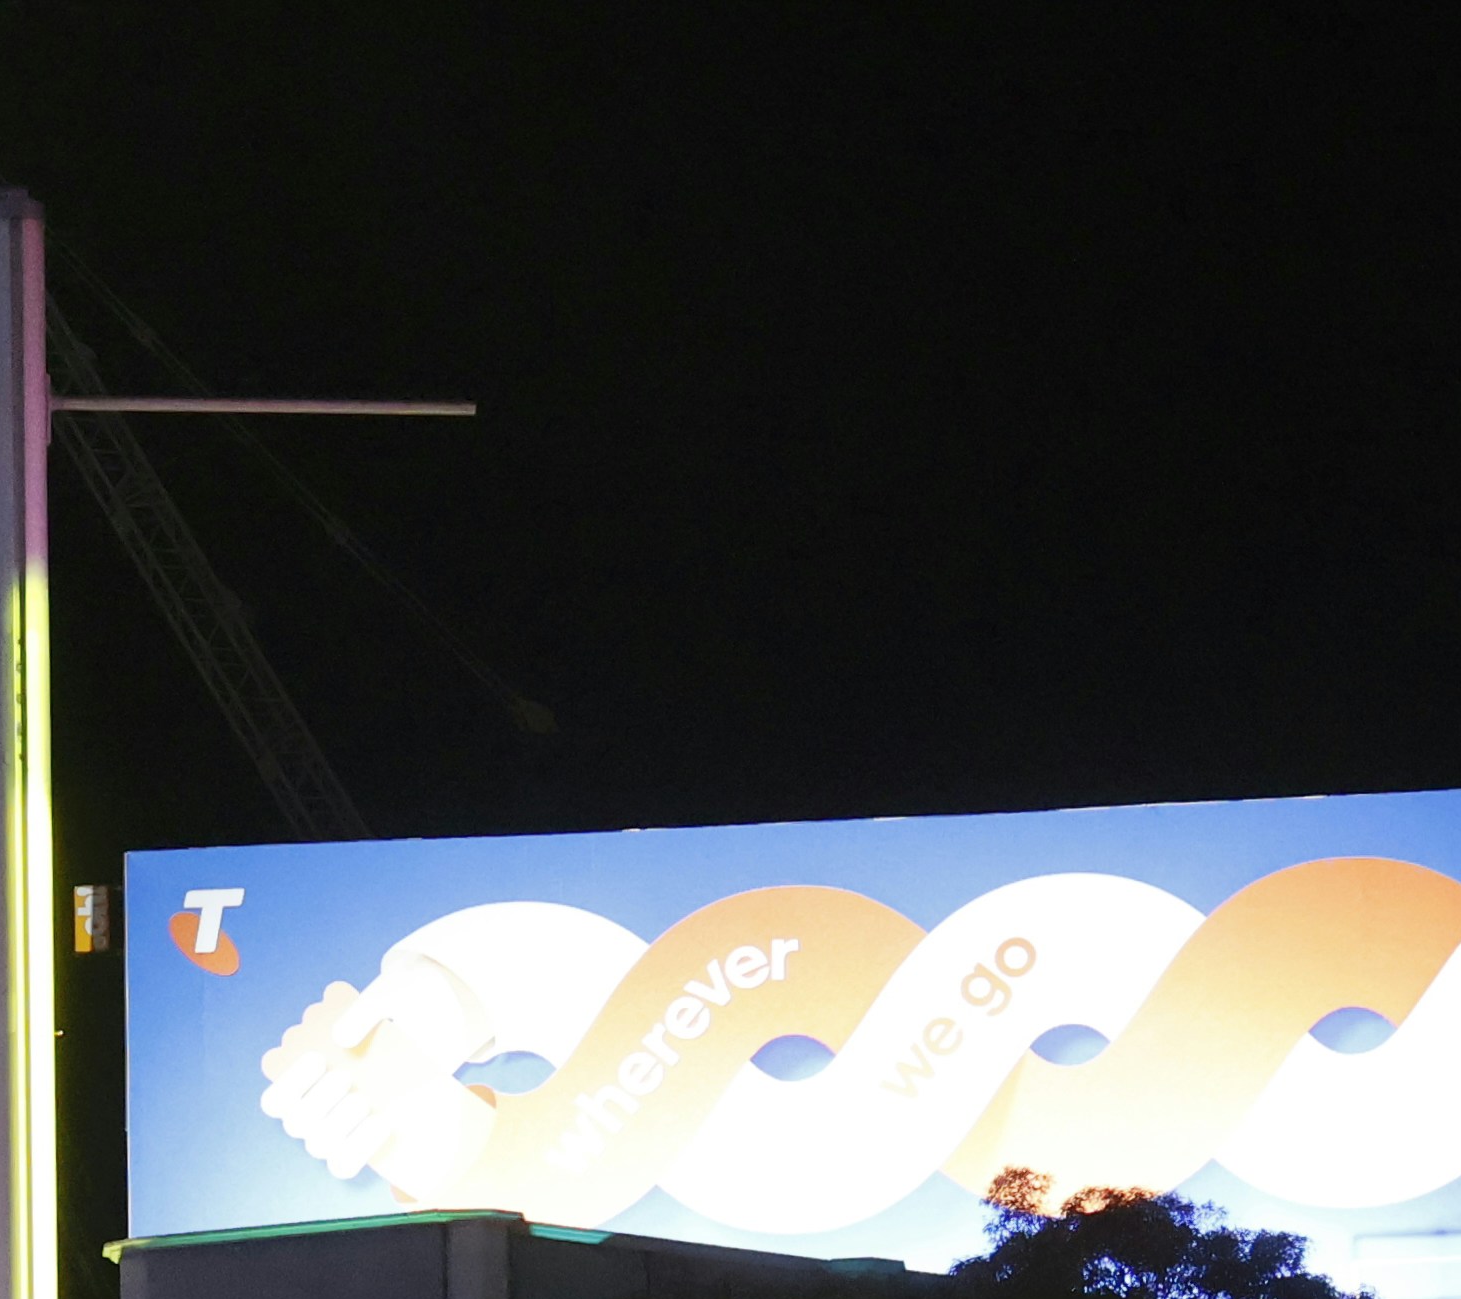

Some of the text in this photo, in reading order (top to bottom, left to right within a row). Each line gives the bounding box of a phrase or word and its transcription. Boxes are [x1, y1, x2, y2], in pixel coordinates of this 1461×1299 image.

[183, 888, 245, 953] T
[544, 937, 1037, 1171] wherever we go
